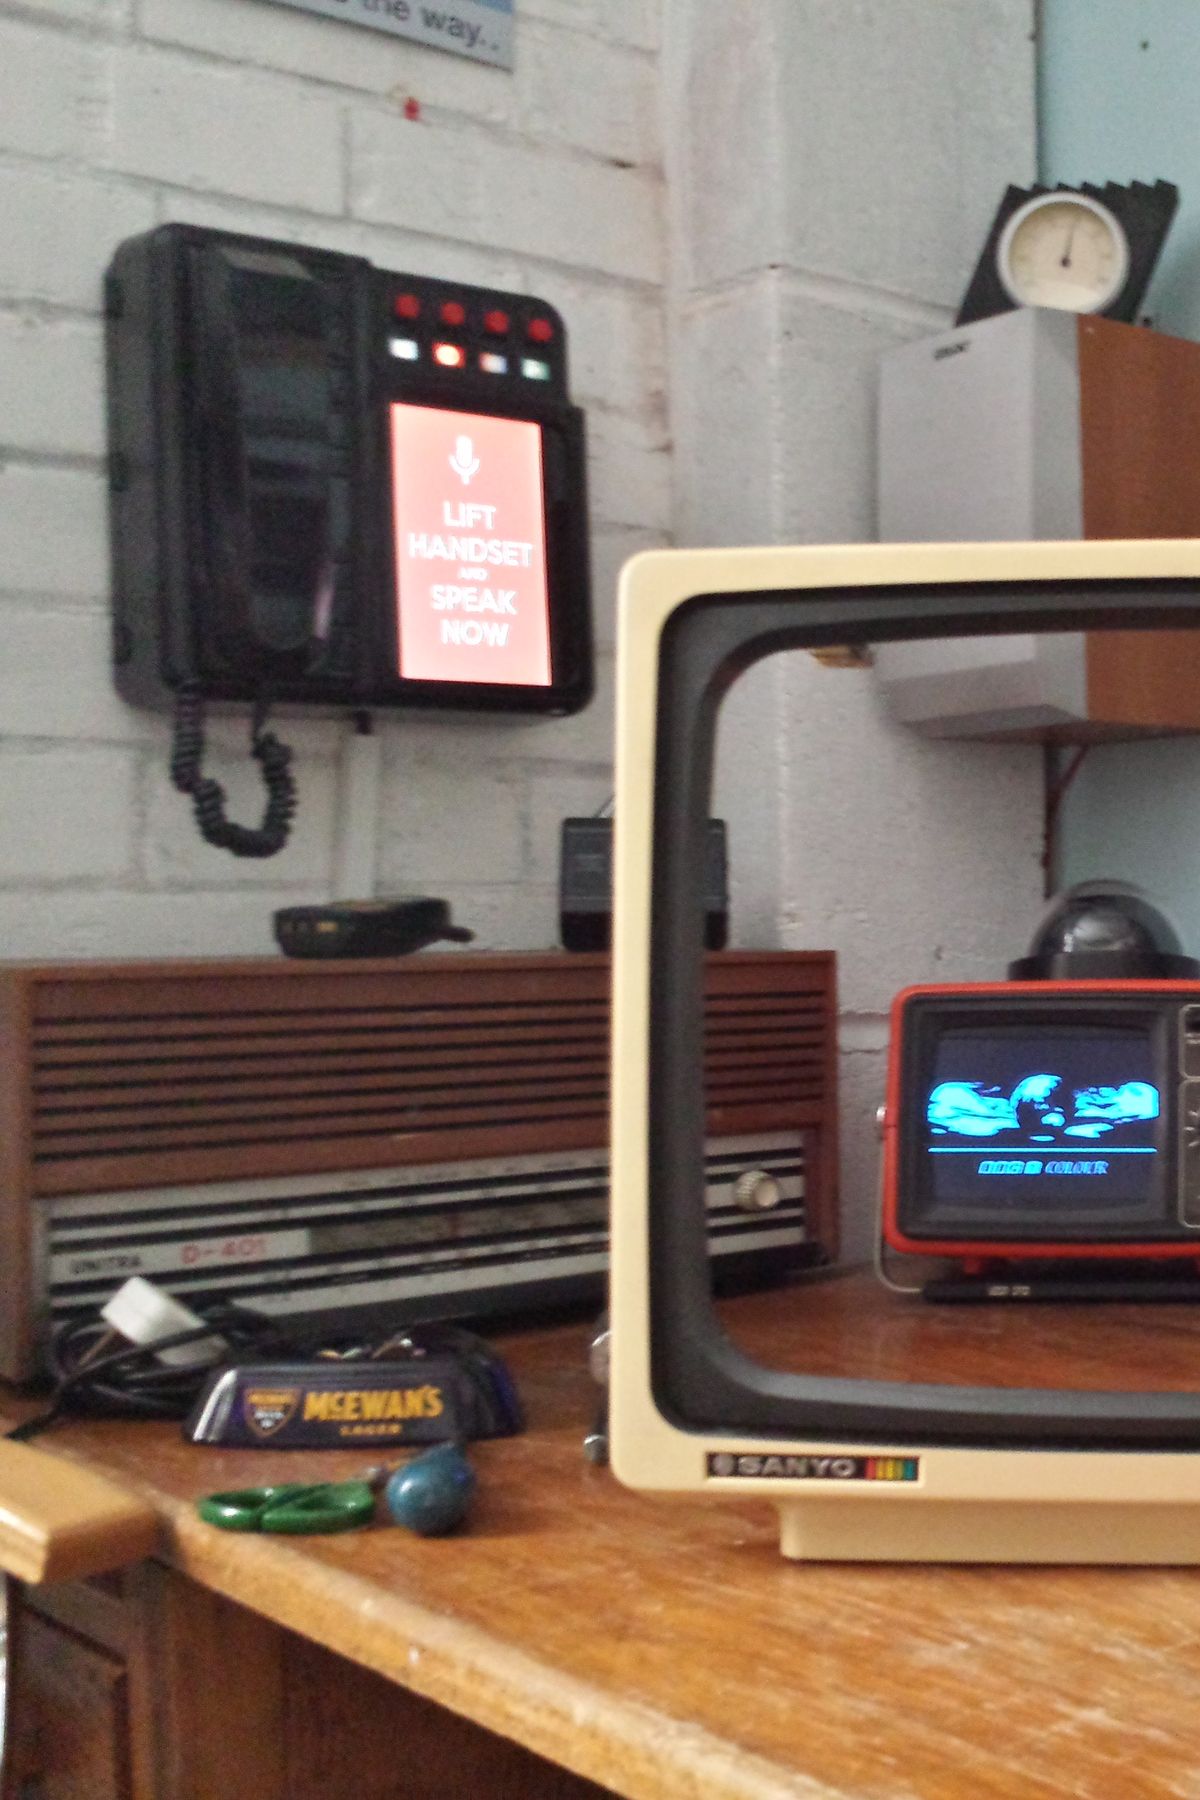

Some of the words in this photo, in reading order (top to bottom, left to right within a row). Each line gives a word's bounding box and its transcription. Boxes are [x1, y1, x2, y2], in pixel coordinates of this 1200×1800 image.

[443, 500, 496, 530] LIFT
[408, 532, 533, 567] HANDSET
[431, 584, 518, 615] SPEAK
[440, 619, 510, 647] NOW
[737, 1455, 857, 1478] SANYO
